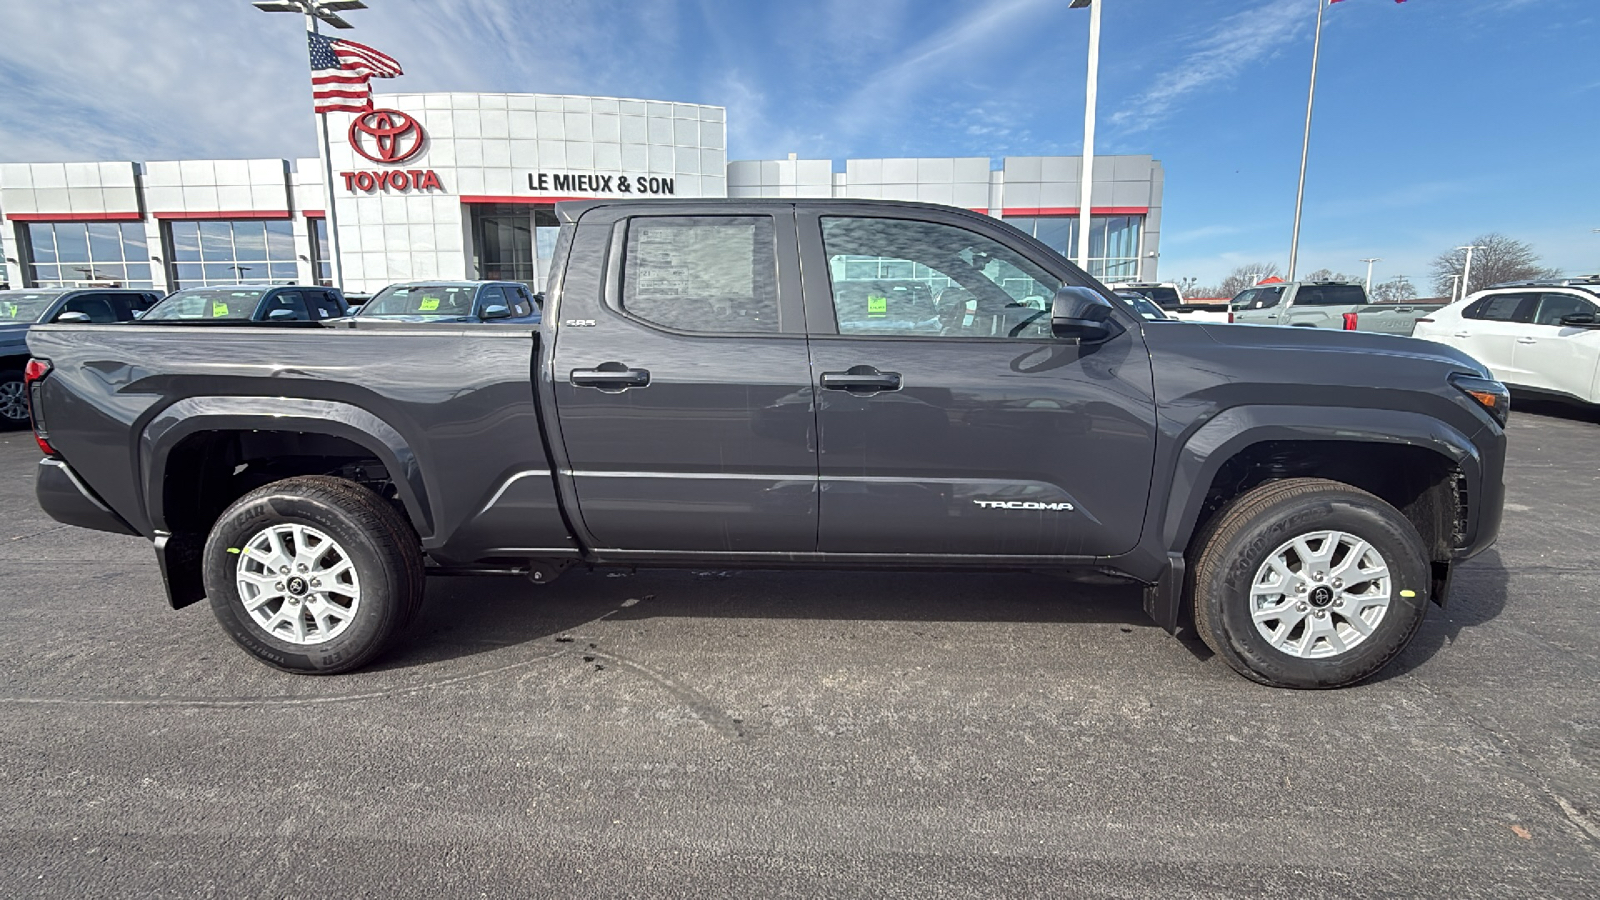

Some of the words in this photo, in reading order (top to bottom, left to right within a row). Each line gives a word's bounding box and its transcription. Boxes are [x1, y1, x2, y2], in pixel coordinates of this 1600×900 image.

[340, 170, 441, 191] TOYOTA
[528, 173, 548, 190] LE
[553, 174, 613, 193] MIEUX
[617, 176, 632, 193] &
[637, 176, 674, 194] SON
[566, 319, 596, 327] SR5
[973, 500, 1074, 511] TACOMA
